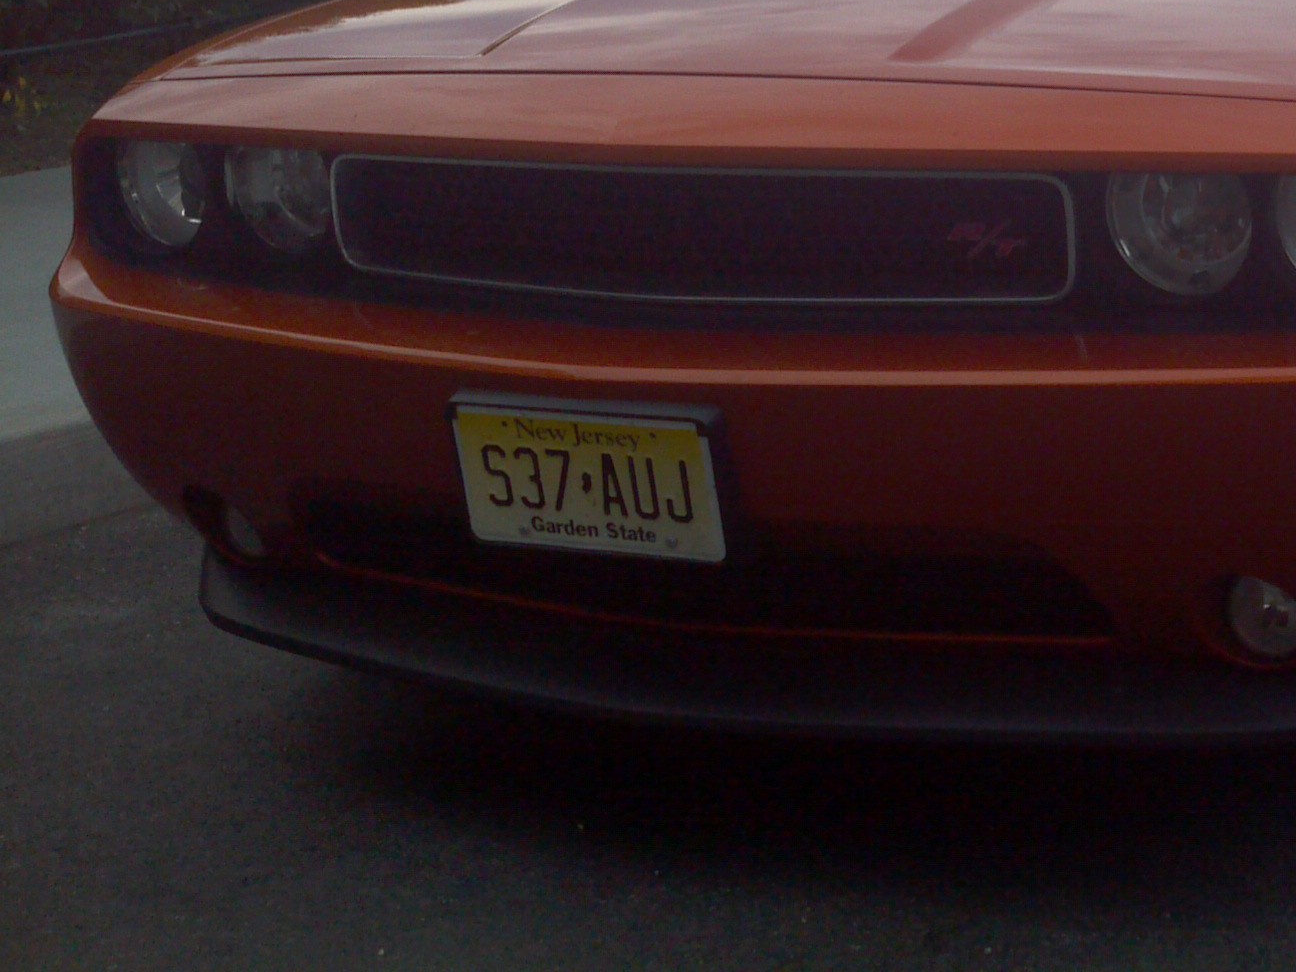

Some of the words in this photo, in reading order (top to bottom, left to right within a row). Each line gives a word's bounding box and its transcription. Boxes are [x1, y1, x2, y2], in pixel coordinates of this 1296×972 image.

[513, 418, 567, 442] New
[572, 422, 642, 451] Jersey
[530, 515, 600, 539] Garden
[606, 522, 657, 543] State
